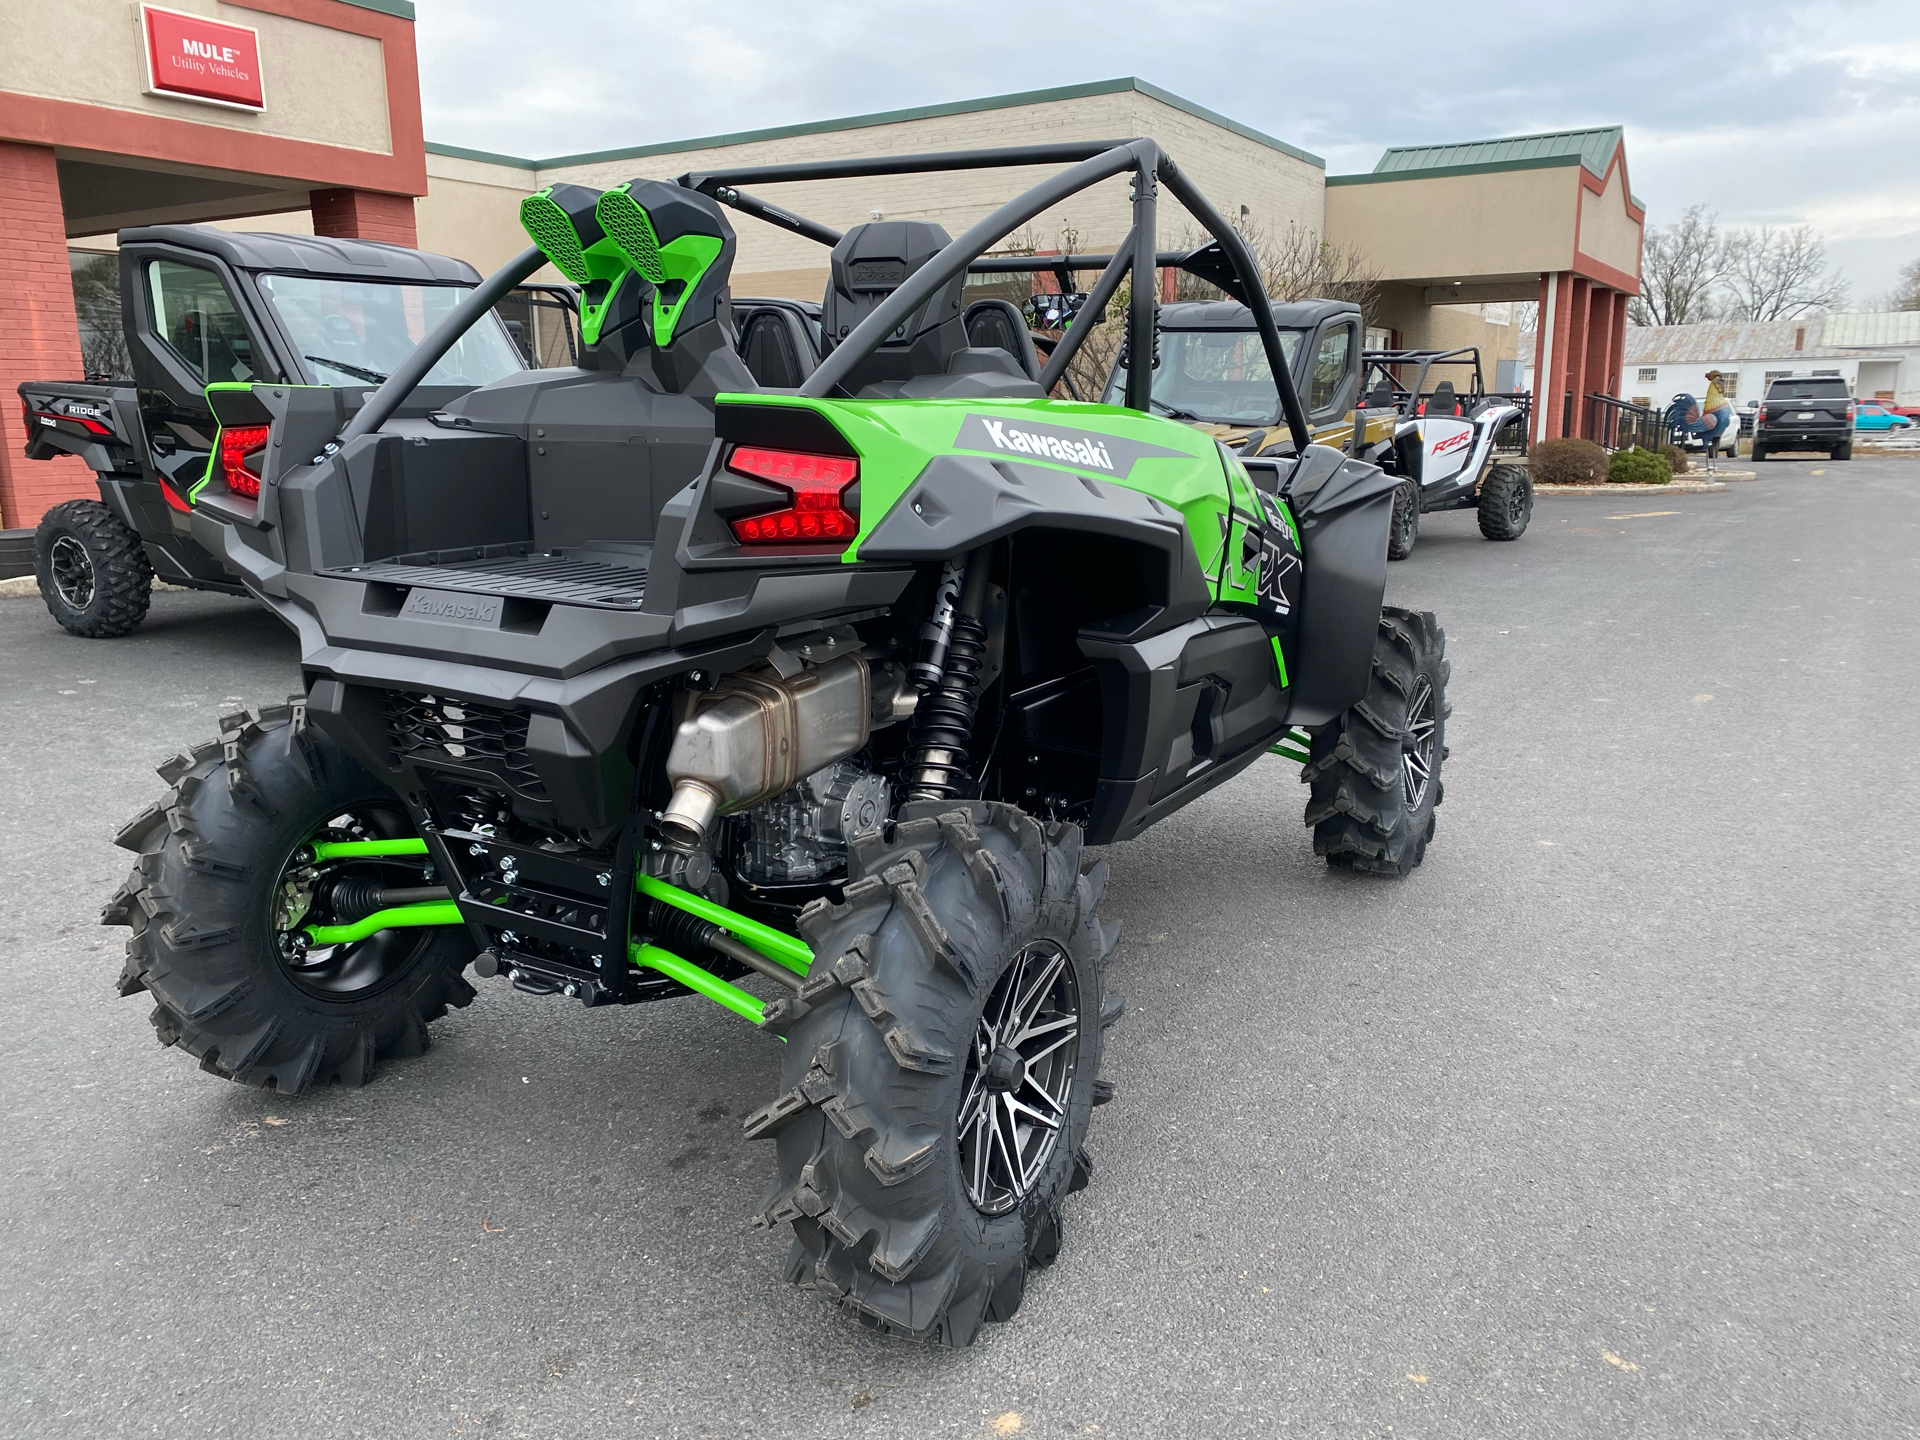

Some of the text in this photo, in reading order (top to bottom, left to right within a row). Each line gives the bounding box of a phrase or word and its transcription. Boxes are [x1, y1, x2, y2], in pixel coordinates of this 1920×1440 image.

[172, 55, 249, 80] Utility Vehicles
[69, 405, 101, 416] RIDGE
[981, 418, 1114, 470] Kawasaki
[1431, 430, 1470, 456] RZR
[932, 560, 965, 629] FOX
[408, 595, 497, 622] Kawasaki
